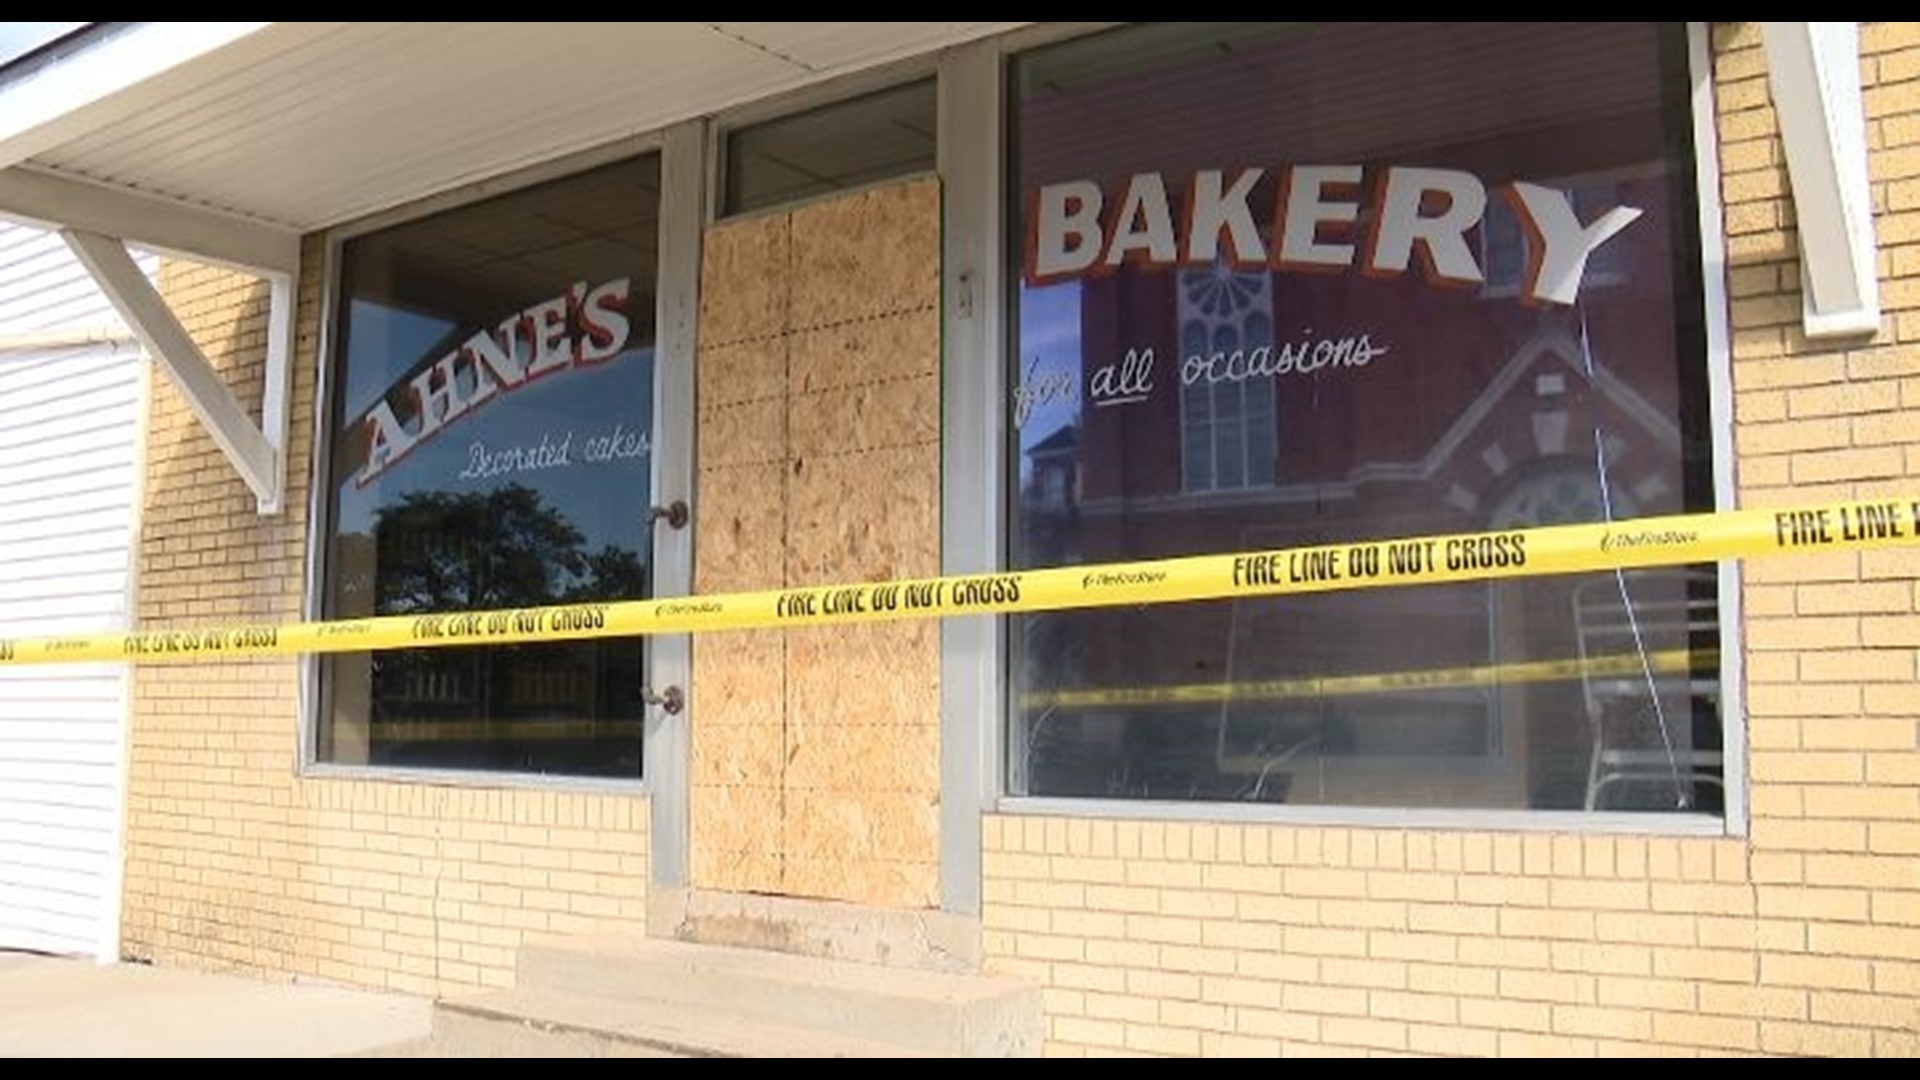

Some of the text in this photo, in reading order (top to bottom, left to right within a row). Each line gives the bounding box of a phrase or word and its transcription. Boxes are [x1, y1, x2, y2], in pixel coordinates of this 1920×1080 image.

[1025, 164, 1644, 307] BAKERY
[356, 278, 631, 489] AHNE'S
[1091, 347, 1154, 404] all
[1181, 328, 1386, 385] occasions
[459, 425, 650, 480] Decorated cakes
[1775, 508, 1833, 547] FIRE
[1841, 502, 1904, 541] LINE
[1233, 534, 1527, 586] FIRE LINE DO NOT CROSS
[823, 589, 865, 615] LINE
